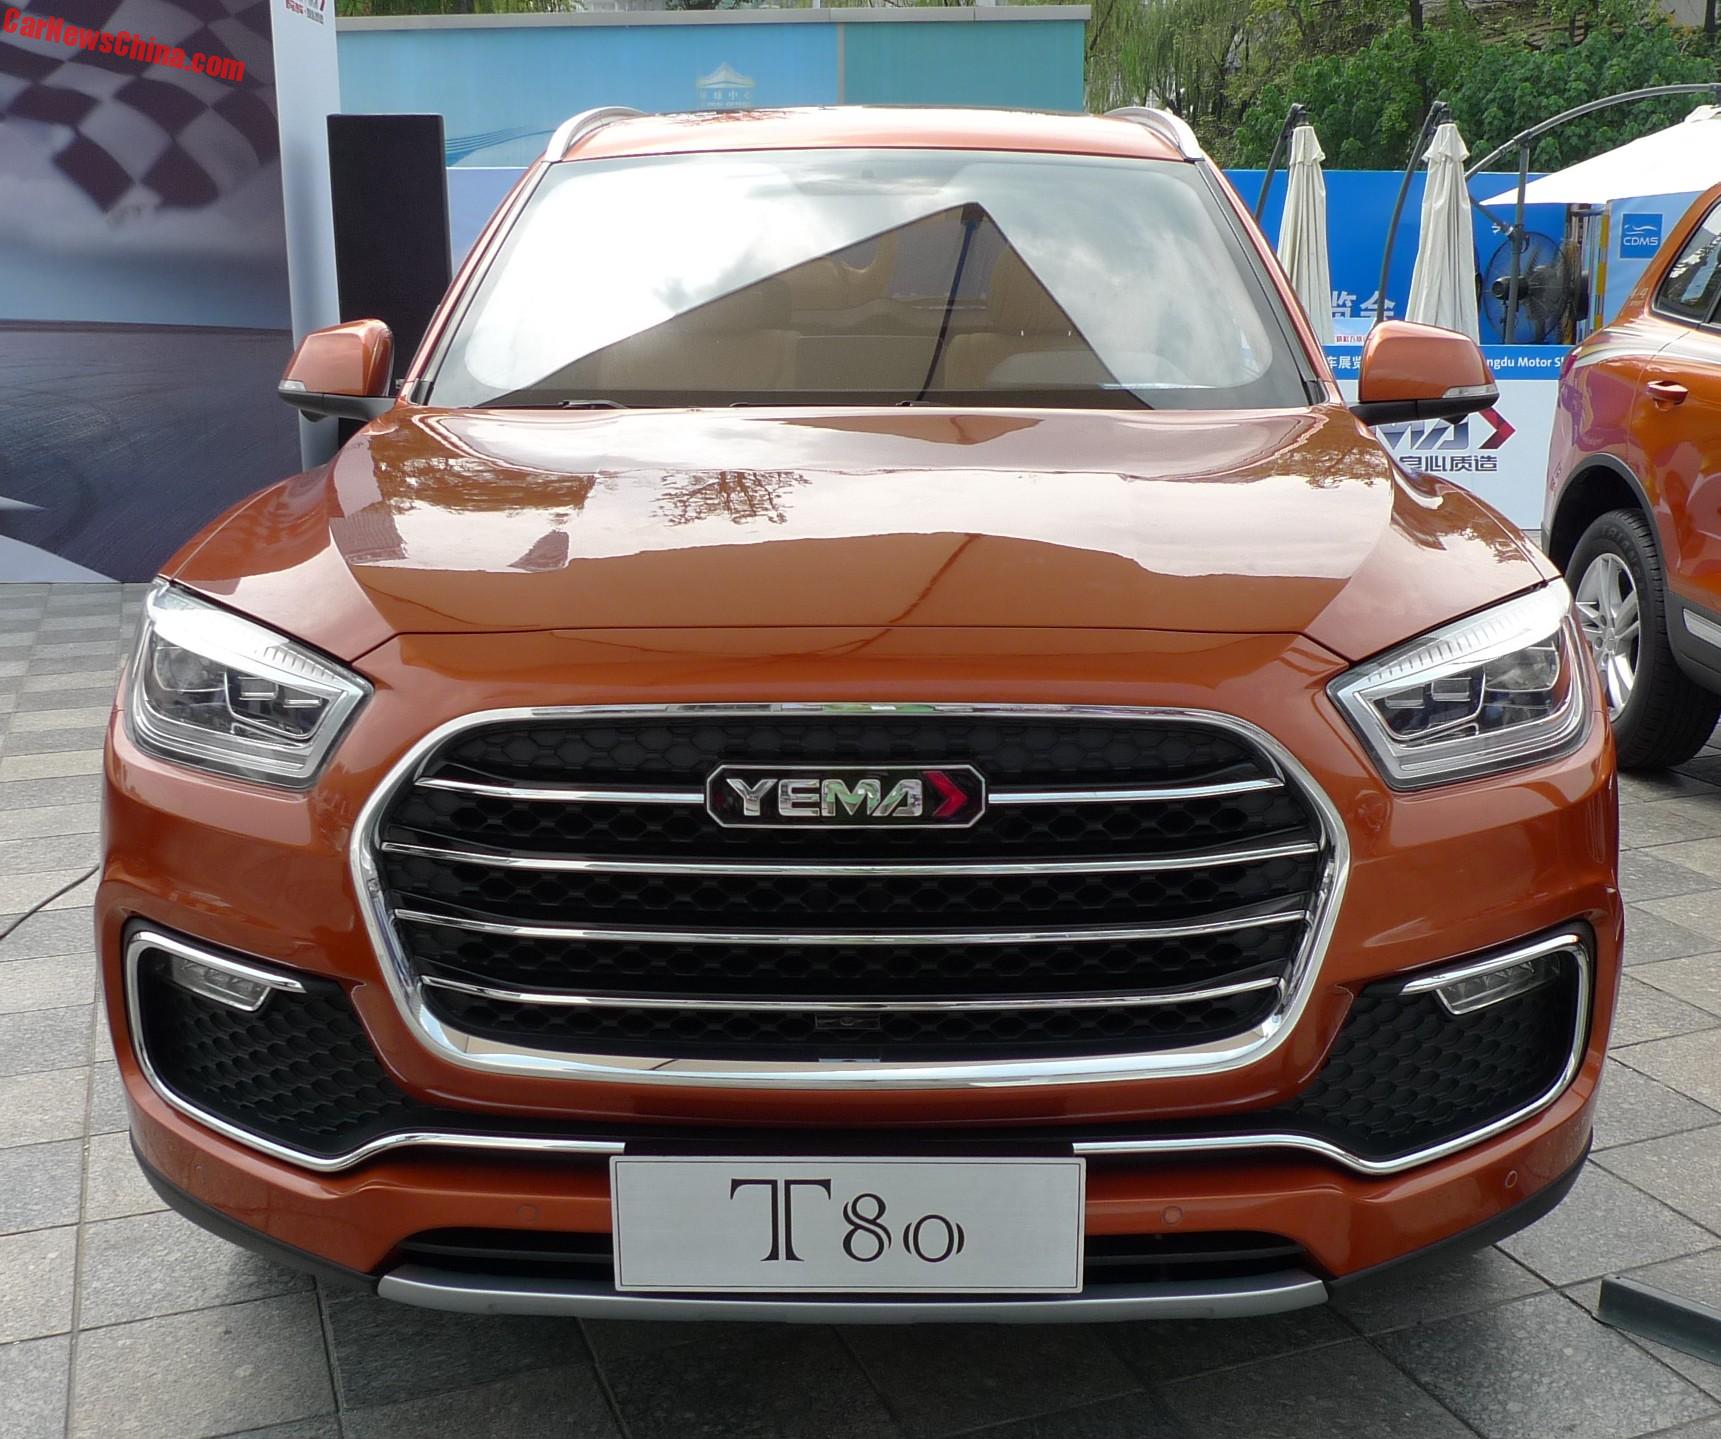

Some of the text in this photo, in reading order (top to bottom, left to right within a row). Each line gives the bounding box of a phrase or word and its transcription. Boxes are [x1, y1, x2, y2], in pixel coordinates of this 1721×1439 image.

[1623, 236, 1659, 246] CDMS
[1518, 356, 1552, 367] Motor
[726, 778, 923, 817] YEMA
[730, 1177, 966, 1263] T80
